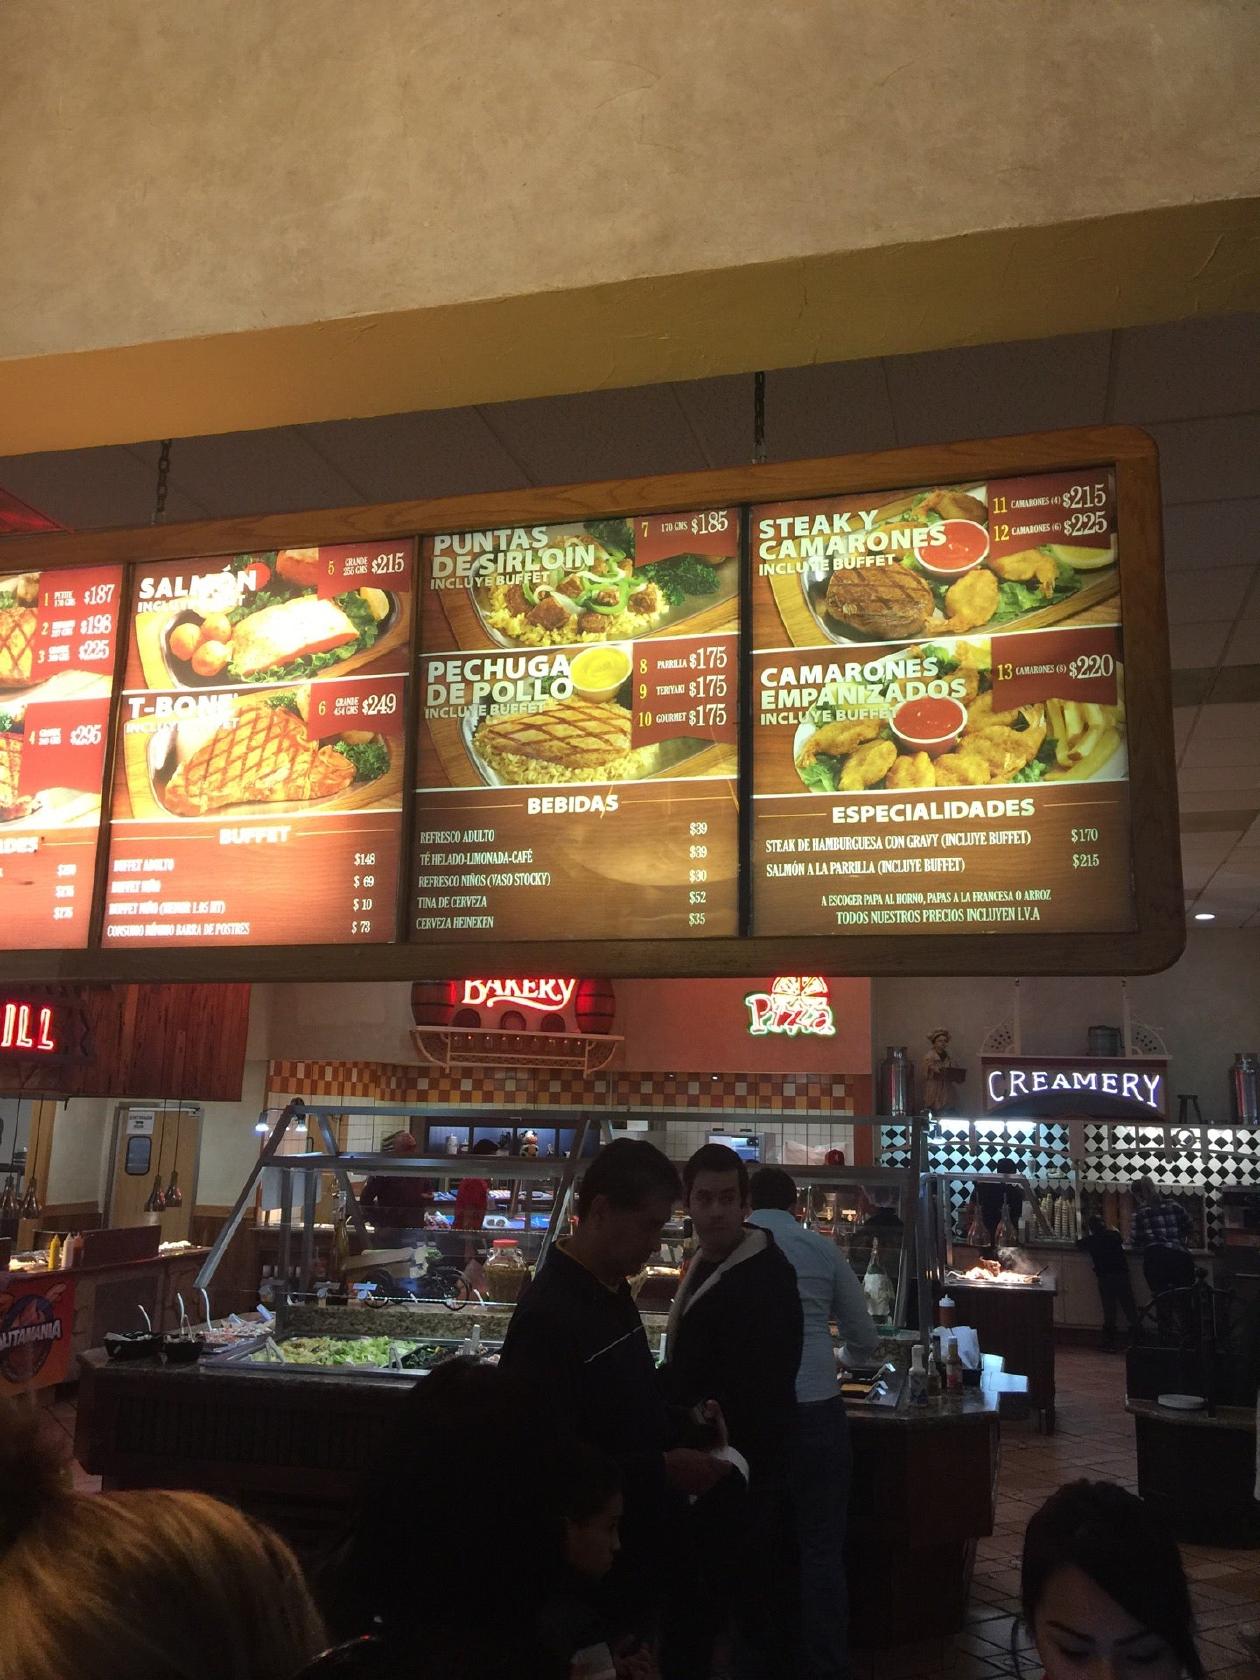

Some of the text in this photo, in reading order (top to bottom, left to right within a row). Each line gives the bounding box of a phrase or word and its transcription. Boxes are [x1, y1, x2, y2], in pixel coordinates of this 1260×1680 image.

[992, 484, 1106, 514] 11 CAMARONES (4) $215
[641, 522, 648, 538] 7
[662, 522, 672, 532] 170
[691, 511, 728, 536] $185
[759, 510, 880, 539] STEAK Y
[994, 511, 1108, 542] 12 CAMARONES (6) $225
[434, 526, 548, 556] PUNTAS
[758, 526, 948, 560] CAMARONES
[328, 560, 334, 576] 5
[372, 552, 405, 574] $215
[432, 545, 594, 578] DE SIRLOIN
[758, 554, 896, 576] INCLUYE BUFFET
[430, 572, 550, 590] INCLUYE BUFFET
[84, 584, 115, 605] $187
[41, 622, 49, 636] 2
[80, 614, 112, 634] $198
[38, 650, 46, 664] 3
[78, 640, 110, 661] $225
[640, 646, 728, 674] 8 PARRILLA $175
[428, 654, 570, 682] PECHUGA
[760, 658, 939, 688] CAMARONES
[998, 664, 1013, 680] 13
[1016, 664, 1054, 676] CAMARONES
[1069, 654, 1114, 680] $220
[427, 678, 574, 706] DE POLLO
[640, 675, 727, 700] 9 TERIYAKI $175
[760, 678, 968, 709] EMPANIZADOS
[318, 700, 326, 716] 6
[362, 694, 396, 716] $249
[424, 700, 546, 719] INCLUYE BUFFET
[638, 704, 727, 728] 10 GOURMET $175
[760, 706, 898, 726] INCLUYE BUFFET
[29, 730, 36, 745] 4
[527, 794, 619, 815] BEBIDAS
[832, 798, 1036, 824] ESPECIALIDADES
[219, 826, 291, 845] BUFFET
[420, 822, 708, 844] REFRESCO ADULTO $39
[766, 828, 1098, 853] STEAK DE HAMBURGUESA CON GRAVY (INCLUYE BUFFET) $170
[354, 853, 375, 866] $148
[420, 851, 430, 866] TÉ
[432, 848, 533, 865] HELADO-LIMONADA-CAFÉ
[766, 854, 1100, 877] SALMÓN A LA PARRILLA (INCLUYE BUFFET) $215
[418, 875, 460, 888] REFRESCO
[461, 872, 486, 886] NIÑOS
[487, 872, 514, 888] (VASO
[514, 872, 551, 886] STOCKY)
[417, 891, 706, 908] TINA DE CERVEZA $52
[822, 890, 1051, 906] A ESCOGER PAPA AL HORNO, PAPAS A LA FRANCESA O ARROZ
[416, 913, 706, 930] CERVEZA HEINEKEN $35
[836, 906, 1040, 924] TODOS NUESTROS PRECIOS INCLUYEN I.V.A
[461, 978, 576, 1010] BAKERY
[746, 994, 836, 1036] Pizza
[988, 1070, 1160, 1108] CREAMERY
